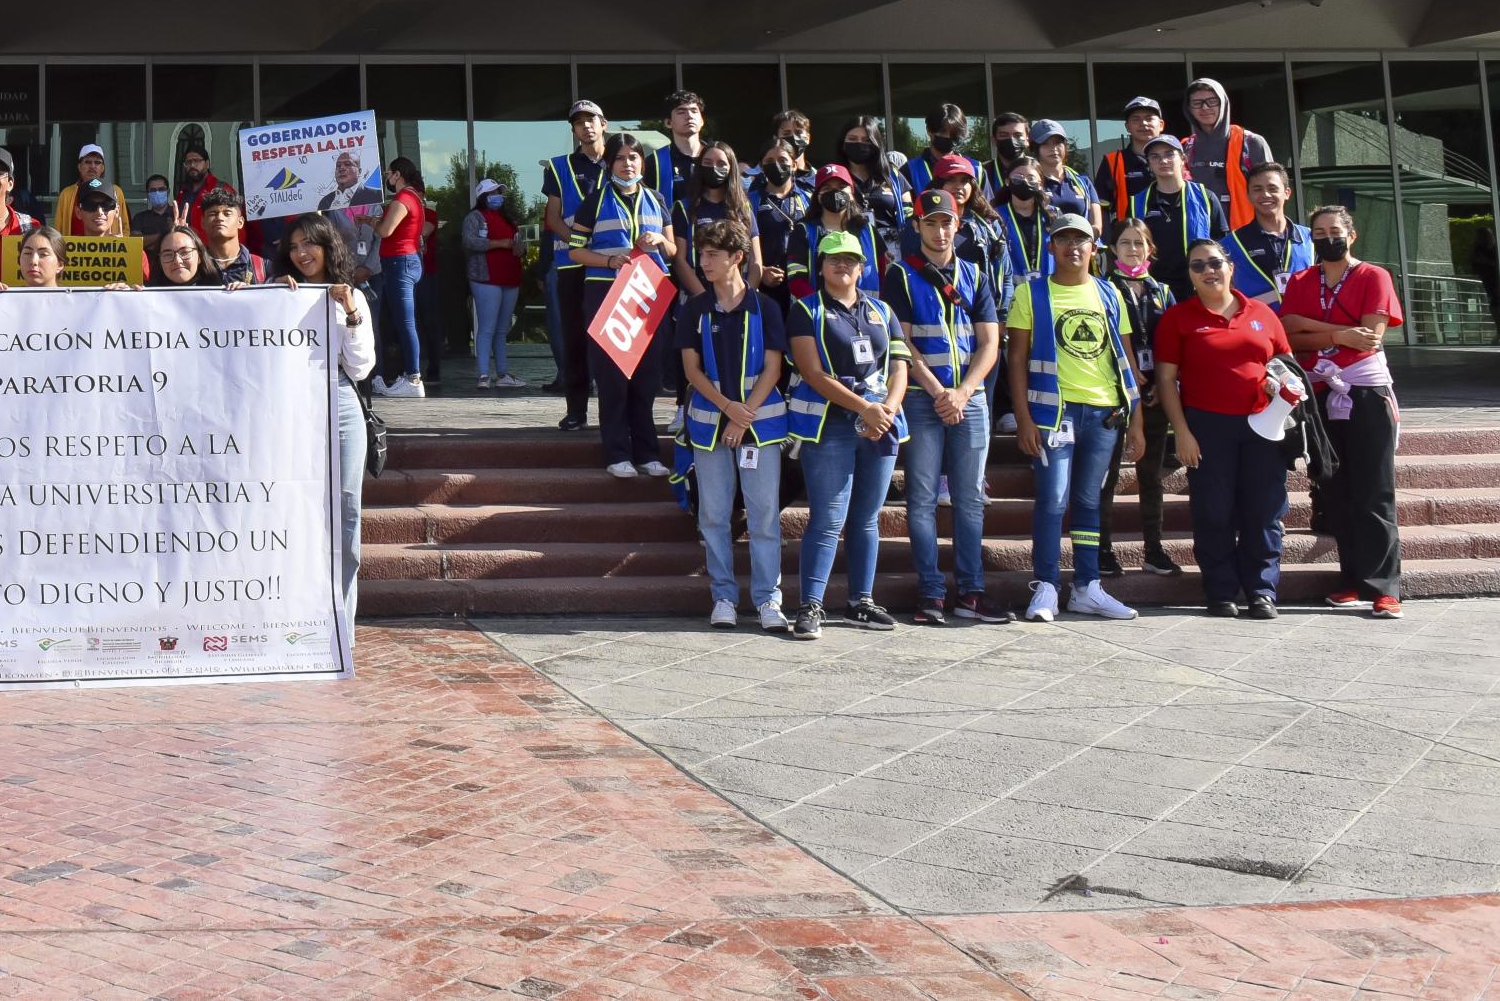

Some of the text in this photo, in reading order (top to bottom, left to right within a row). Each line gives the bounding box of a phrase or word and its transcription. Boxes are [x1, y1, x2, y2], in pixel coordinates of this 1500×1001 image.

[247, 119, 367, 147] GOBERNADOR:
[251, 143, 315, 162] RESPETA
[317, 139, 336, 152] LA
[338, 135, 365, 150] LEY
[62, 269, 128, 282] NEGOCIA
[604, 261, 658, 352] ALTO
[103, 327, 190, 352] MEDIA
[198, 326, 322, 350] SUPERIOR
[152, 371, 169, 394] 9
[44, 434, 169, 459] RESPETO
[179, 435, 198, 457] A
[207, 433, 241, 456] LA
[29, 481, 253, 507] UNIVERSITARIA
[257, 480, 277, 504] Y
[18, 530, 240, 557] DEFENDIENDO
[248, 529, 289, 552] UN
[39, 579, 145, 607] DIGNO
[153, 581, 173, 605] Y
[182, 575, 282, 608] JUSTO!!
[186, 622, 247, 631] WELCOME
[230, 634, 269, 643] SEMS
